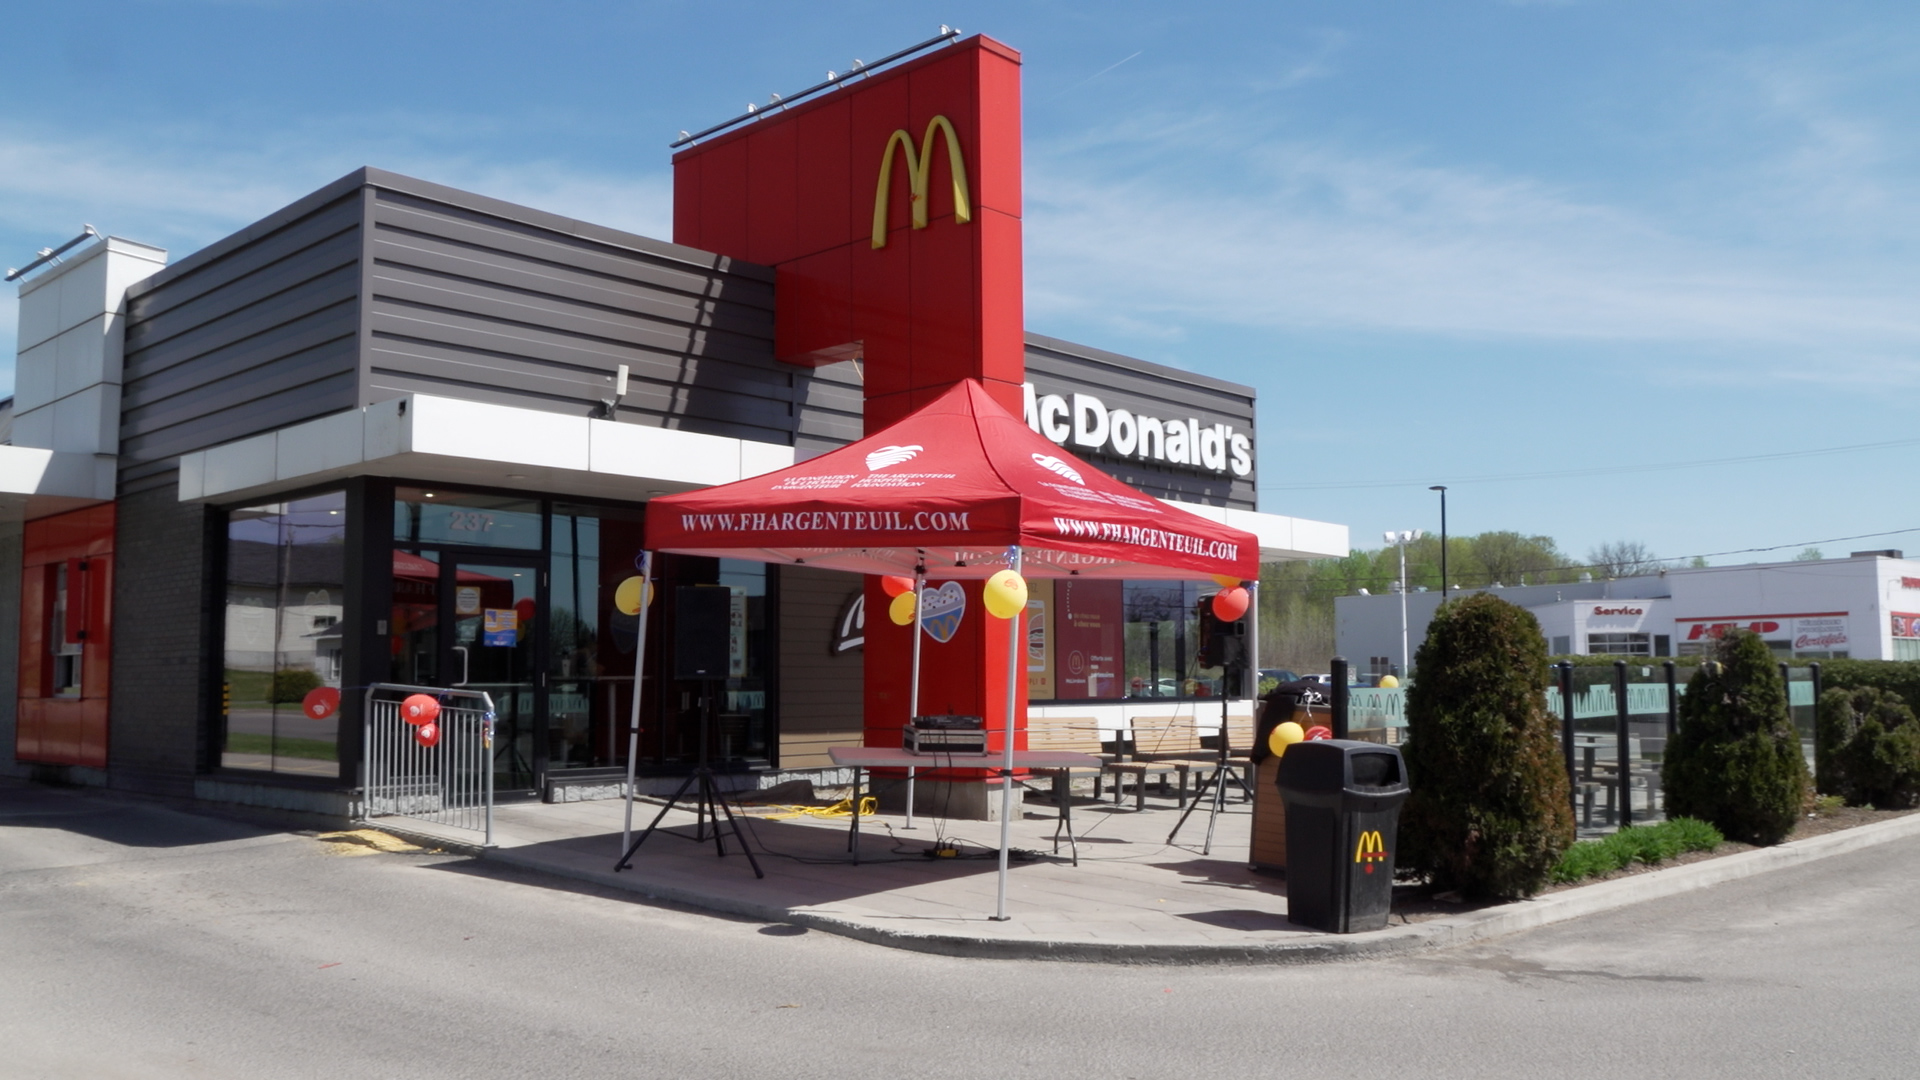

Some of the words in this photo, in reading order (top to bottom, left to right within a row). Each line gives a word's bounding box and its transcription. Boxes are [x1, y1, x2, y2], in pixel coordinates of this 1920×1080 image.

[449, 510, 497, 532] 237
[681, 511, 970, 532] WWW.FHARGENTEUIL.COM
[1053, 517, 1238, 562] WWW.FHARGENTEUIL.COM
[1593, 605, 1643, 616] Service
